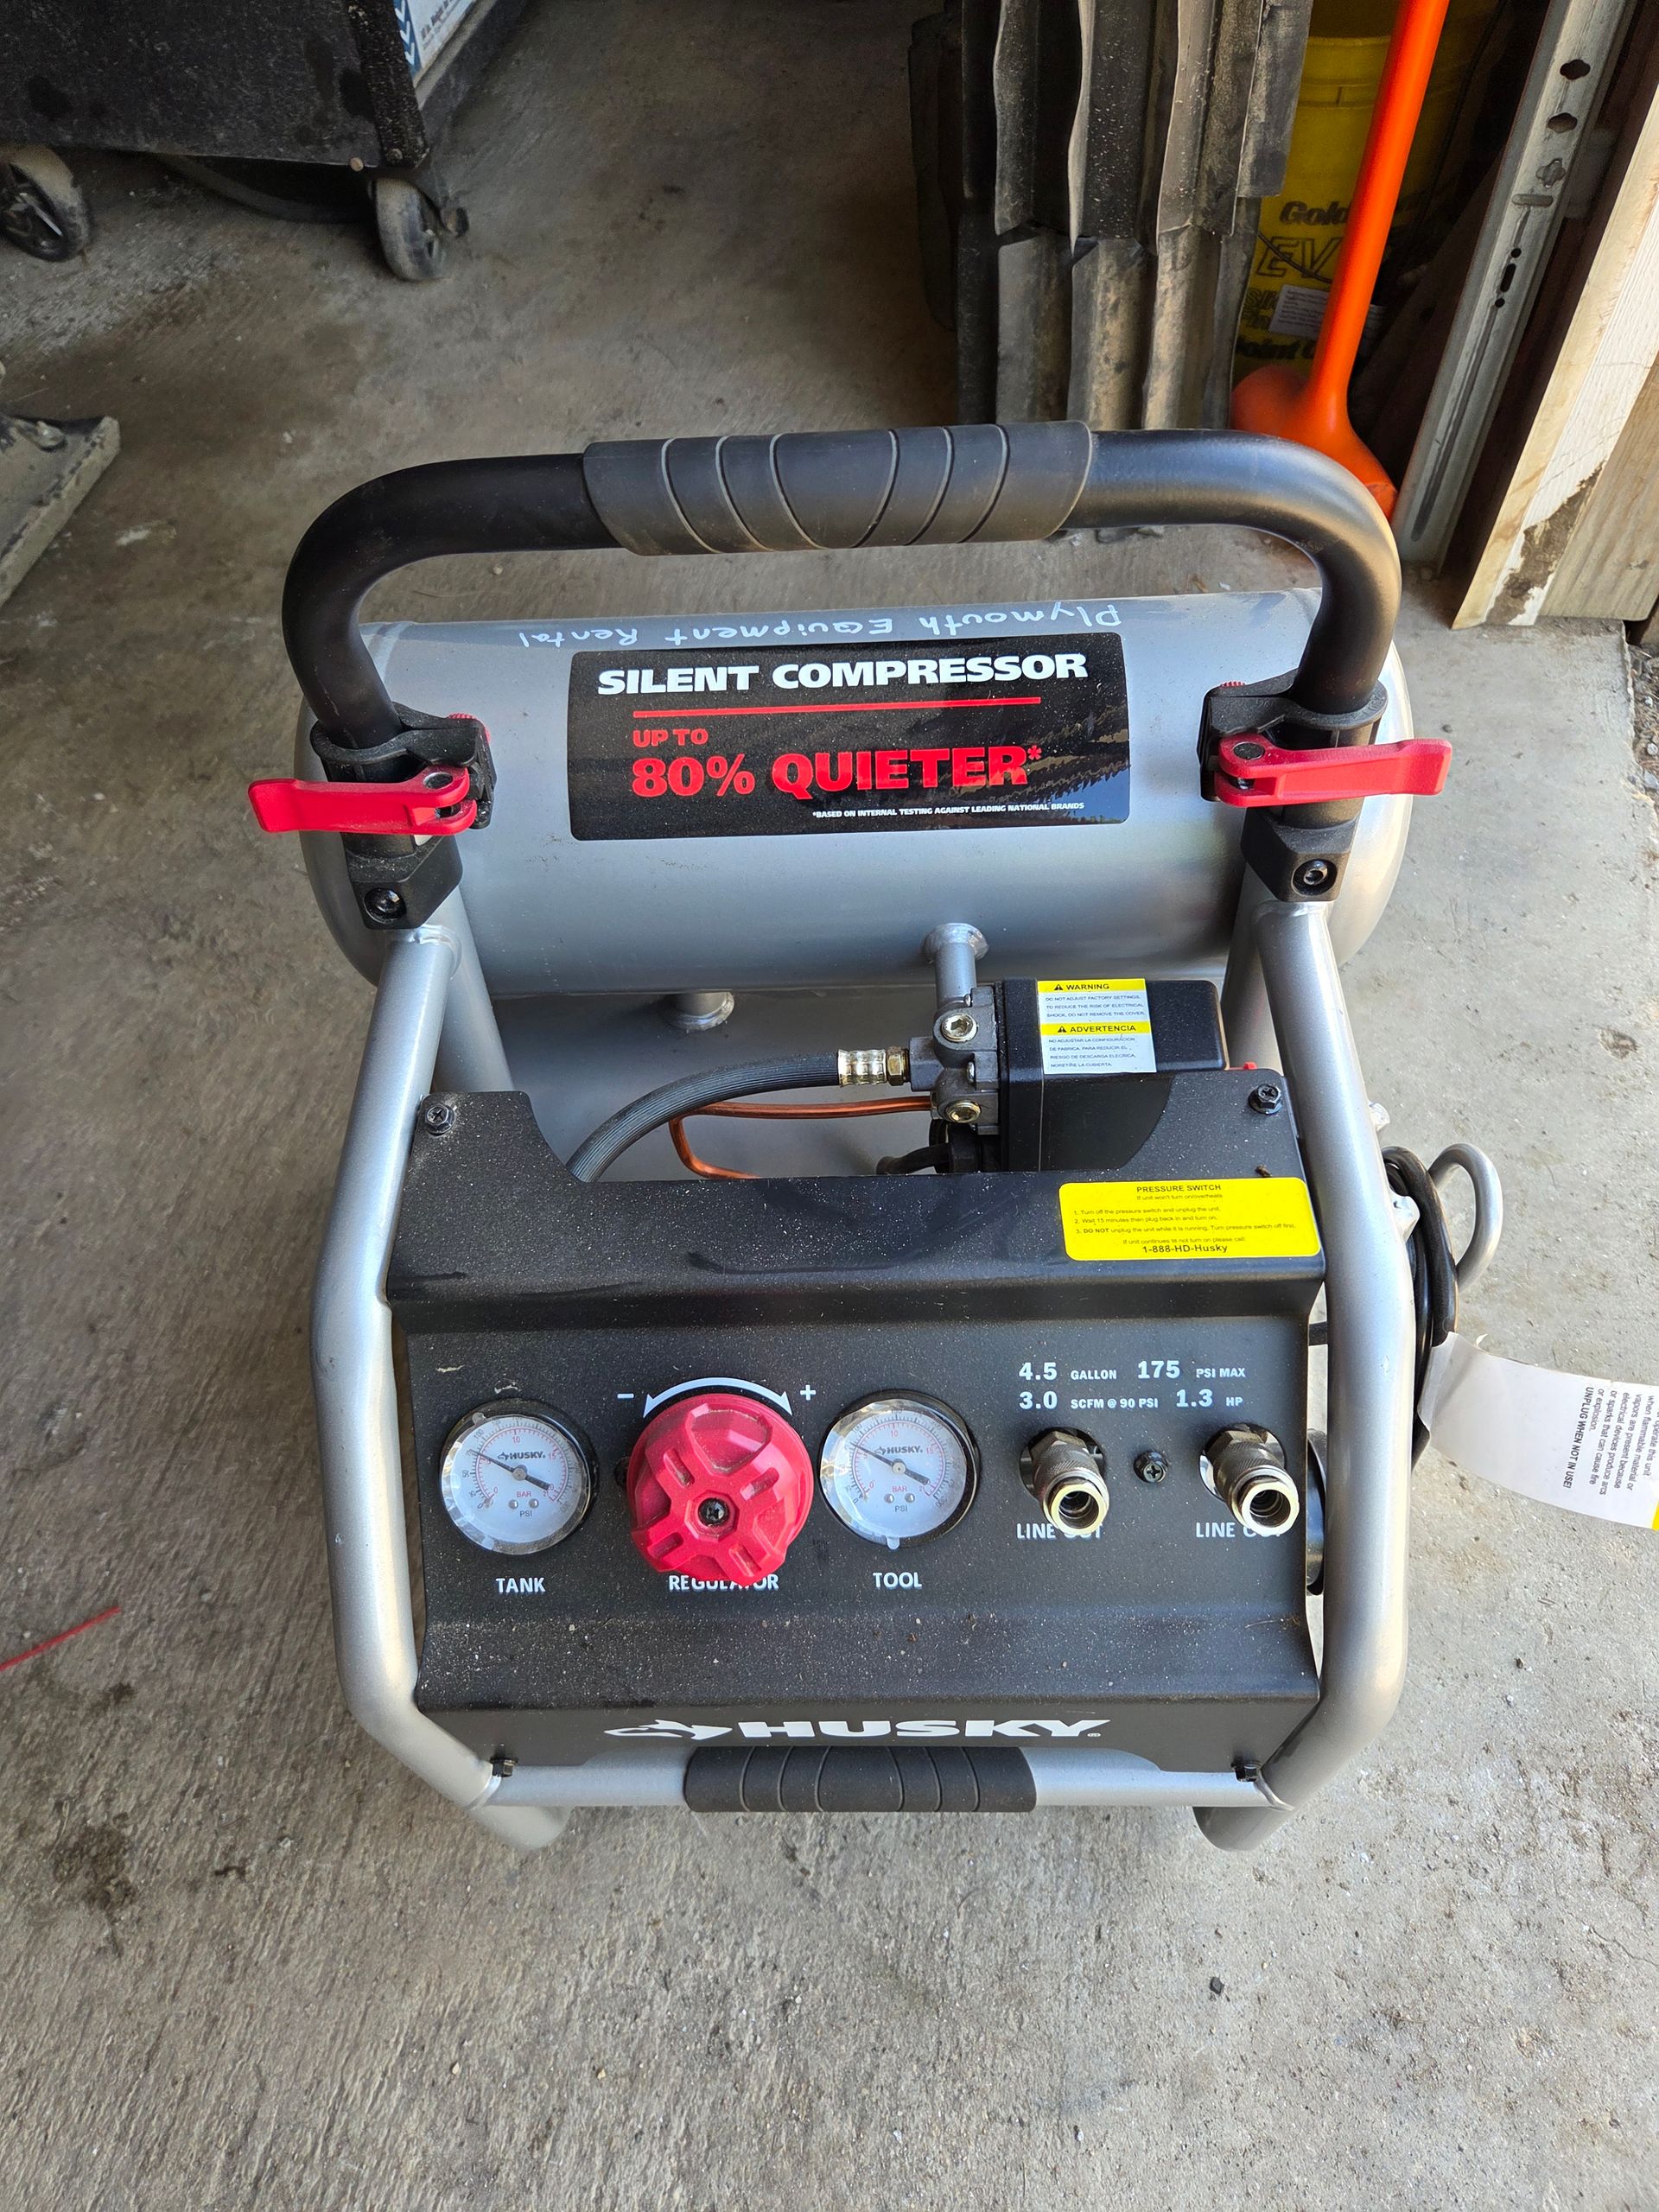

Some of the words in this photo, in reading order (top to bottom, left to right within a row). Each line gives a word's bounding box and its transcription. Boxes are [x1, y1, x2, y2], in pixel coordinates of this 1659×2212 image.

[919, 601, 1122, 635] Plymouth
[518, 627, 639, 648] Rental
[664, 618, 893, 646] Equipment
[597, 664, 760, 696] SILENT
[772, 653, 1089, 690] COMPRESSOR
[632, 728, 668, 747] UP
[677, 728, 709, 746] TO
[632, 753, 755, 798] 80%
[899, 807, 933, 816] TESTING
[971, 805, 1007, 814] LEADING
[1007, 804, 1050, 812] NATIONAL
[1051, 802, 1084, 810] BRANDS
[1142, 1244, 1228, 1253] 1-888-HD-Husky
[1019, 1362, 1058, 1381] 4.5
[1071, 1370, 1116, 1380] GALLON
[1138, 1360, 1180, 1378] 175
[1196, 1368, 1216, 1378] PSI
[1219, 1367, 1246, 1377] MAX
[1019, 1391, 1058, 1409] 3.0
[1071, 1398, 1103, 1408] SCFM
[1108, 1398, 1116, 1408] @
[1120, 1398, 1135, 1408] 90
[1139, 1398, 1158, 1408] PSI
[1176, 1389, 1213, 1408] 1.3
[1225, 1396, 1243, 1407] HP
[1580, 1387, 1594, 1419] UNPLUG
[1618, 1393, 1630, 1424] electrical
[1631, 1395, 1643, 1418] vapors
[1645, 1395, 1655, 1414] when
[1589, 1398, 1604, 1431] explosion.
[1604, 1400, 1616, 1422] sparks
[1573, 1421, 1586, 1444] WHEN
[1600, 1424, 1611, 1438] that
[1628, 1420, 1637, 1431] are
[1636, 1417, 1651, 1452] flammable
[1597, 1439, 1606, 1452] can
[1611, 1425, 1623, 1451] devices
[1622, 1433, 1633, 1459] present
[509, 1452, 544, 1460] HUSKY
[1569, 1445, 1580, 1461] NOT
[1592, 1453, 1602, 1472] cause
[1647, 1449, 1656, 1461] this
[1604, 1452, 1616, 1479] produce
[1614, 1460, 1628, 1488] because
[1629, 1454, 1641, 1482] material
[1562, 1471, 1574, 1489] USE!
[1590, 1474, 1599, 1484] fire
[1599, 1482, 1609, 1496] arcs
[1017, 1523, 1056, 1539] LINE
[1196, 1522, 1236, 1538] LINE
[496, 1578, 545, 1592] TANK
[669, 1574, 779, 1591] REGULAOR
[873, 1573, 922, 1587] TOOL
[738, 1719, 1110, 1737] HUSKY
